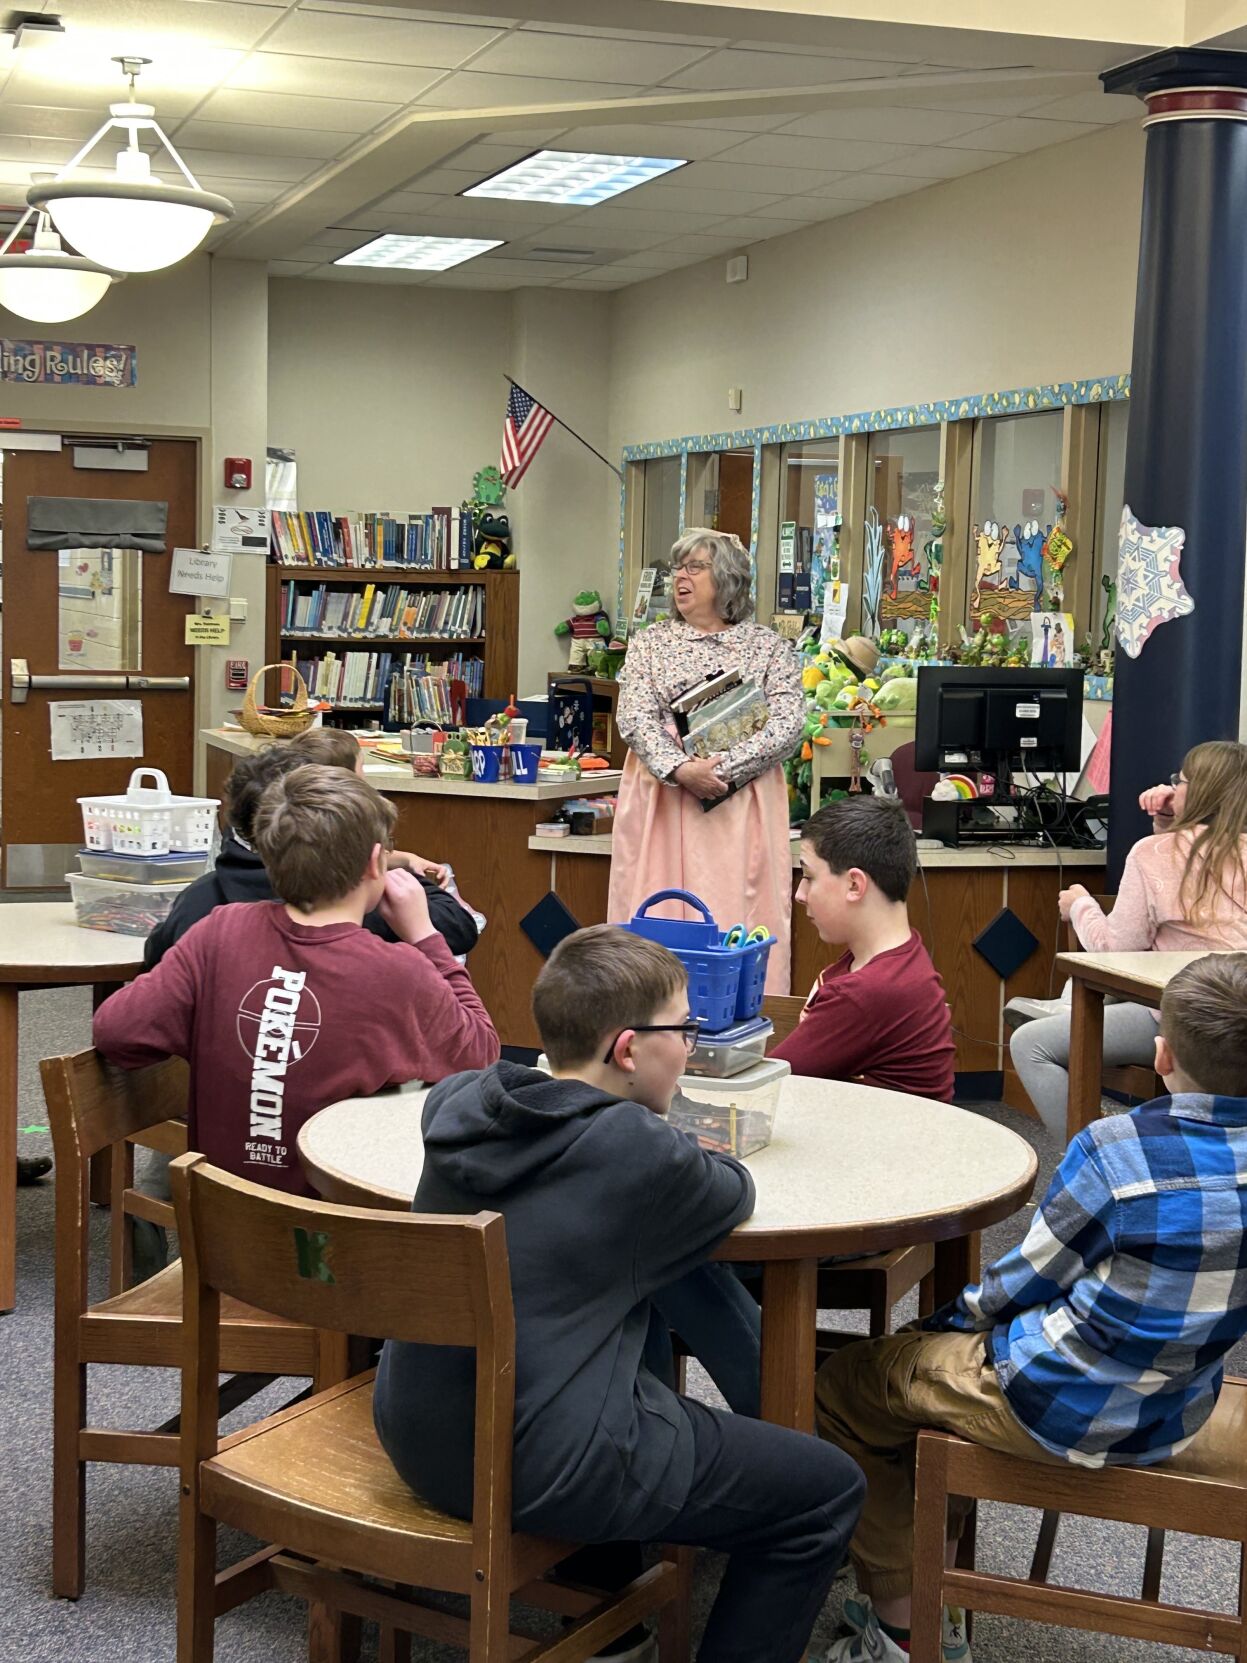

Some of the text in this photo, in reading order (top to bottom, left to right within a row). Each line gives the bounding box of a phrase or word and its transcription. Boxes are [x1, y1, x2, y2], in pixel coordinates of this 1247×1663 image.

[0, 346, 41, 382] ing
[189, 557, 218, 568] Library
[177, 570, 224, 582] Needs Help
[245, 1141, 288, 1156] READY TO
[249, 1151, 282, 1165] BATTLE
